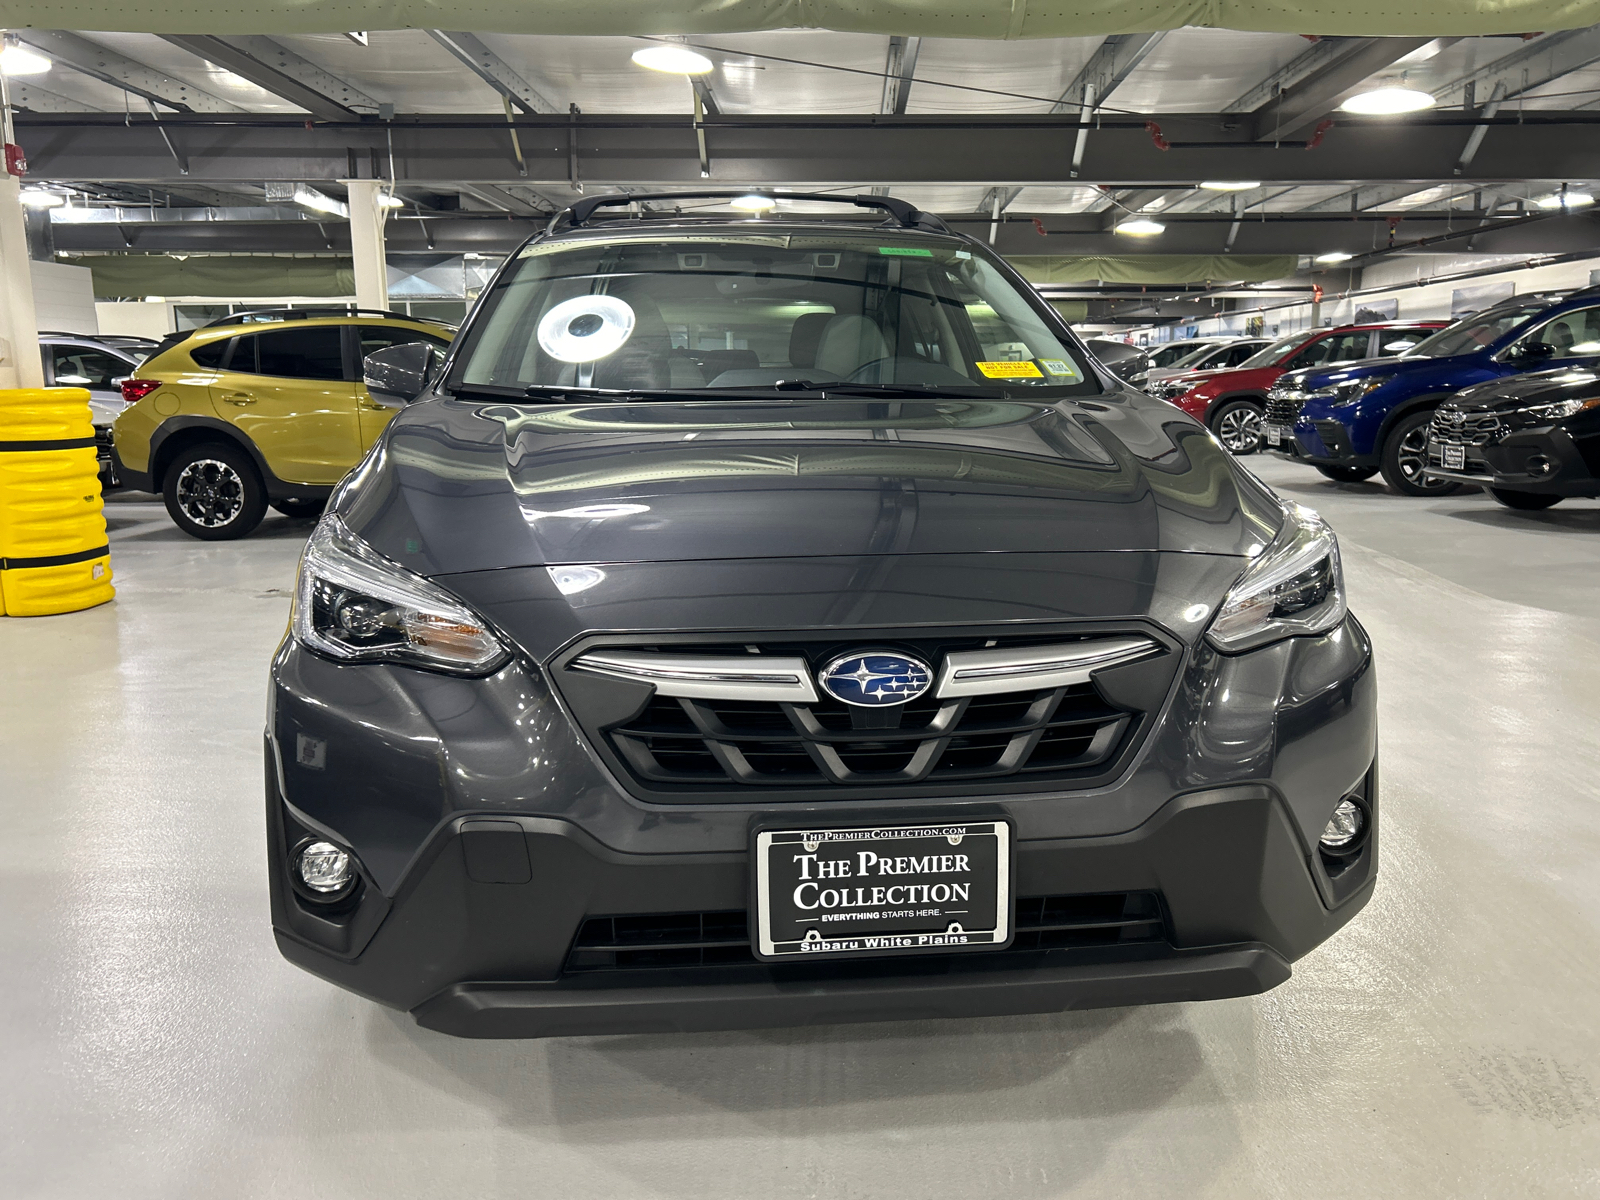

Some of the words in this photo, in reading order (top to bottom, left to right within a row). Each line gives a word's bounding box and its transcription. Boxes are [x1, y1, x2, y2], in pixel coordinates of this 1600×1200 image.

[800, 828, 967, 842] THEPREMIERCOLLECTION.COM
[793, 853, 851, 880] THE
[856, 851, 971, 876] PREMIER
[793, 882, 971, 910] COLLECTION
[821, 912, 880, 922] EVERYTHING
[881, 910, 915, 919] STARTS
[916, 909, 942, 917] HERE.
[800, 940, 859, 952] Subaru
[864, 937, 912, 948] White
[918, 934, 968, 945] Plains
